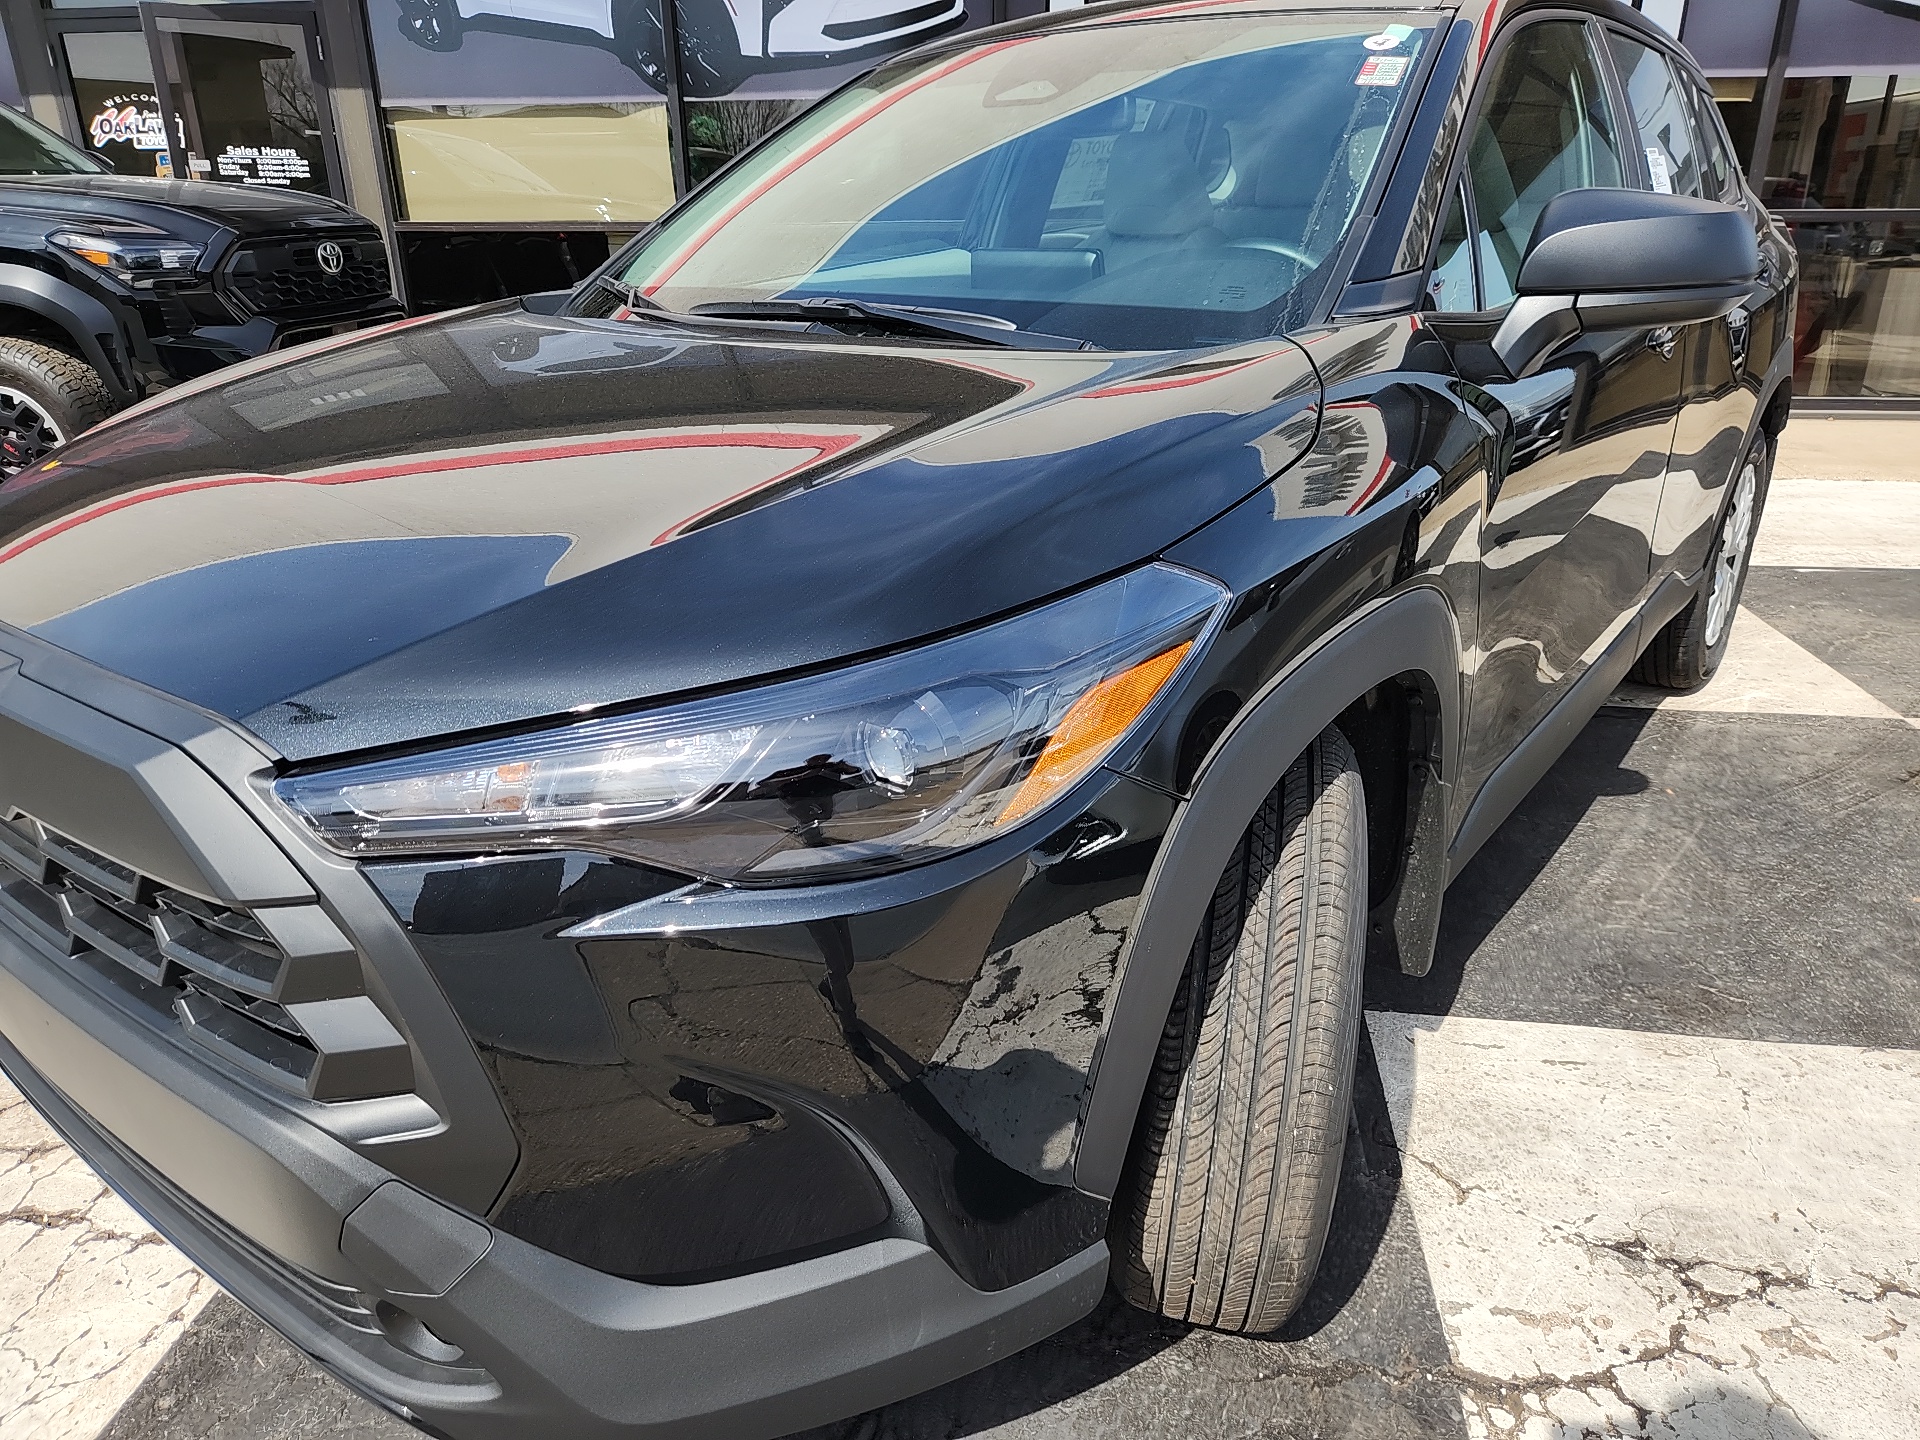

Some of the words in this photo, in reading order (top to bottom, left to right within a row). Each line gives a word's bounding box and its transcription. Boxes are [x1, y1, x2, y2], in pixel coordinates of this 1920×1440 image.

[102, 93, 159, 108] WELCOM
[139, 136, 167, 146] TOYO
[226, 145, 259, 155] Sales
[261, 146, 297, 157] Hours
[1086, 140, 1113, 155] TOYO
[218, 163, 240, 171] Friday
